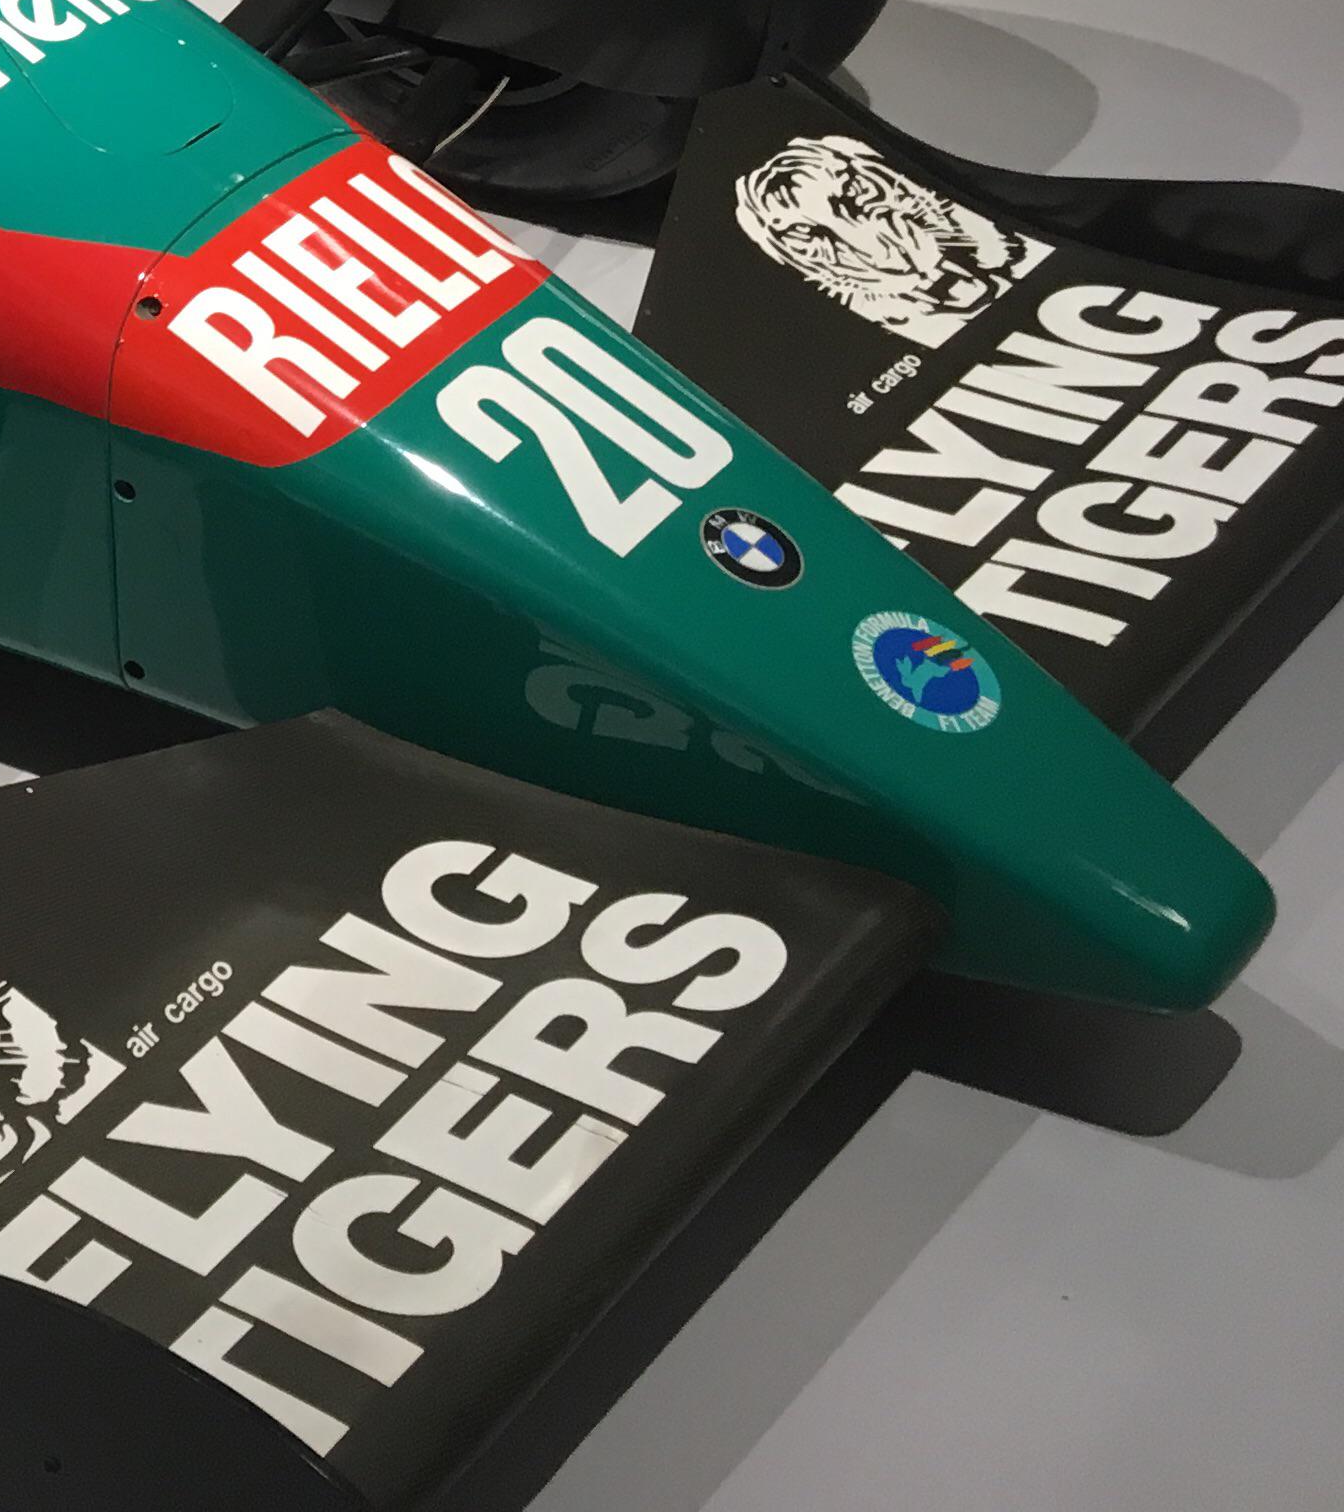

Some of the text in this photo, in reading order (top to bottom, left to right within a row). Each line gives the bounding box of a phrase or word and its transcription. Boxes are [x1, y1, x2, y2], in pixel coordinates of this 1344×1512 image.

[435, 317, 734, 558] 20
[833, 284, 1221, 550] LYING
[846, 353, 922, 415] air cargo
[954, 308, 1344, 648] TIGERS
[960, 695, 1000, 731] TEAM
[125, 958, 234, 1059] air cargo
[168, 892, 788, 1458] TIGERS
